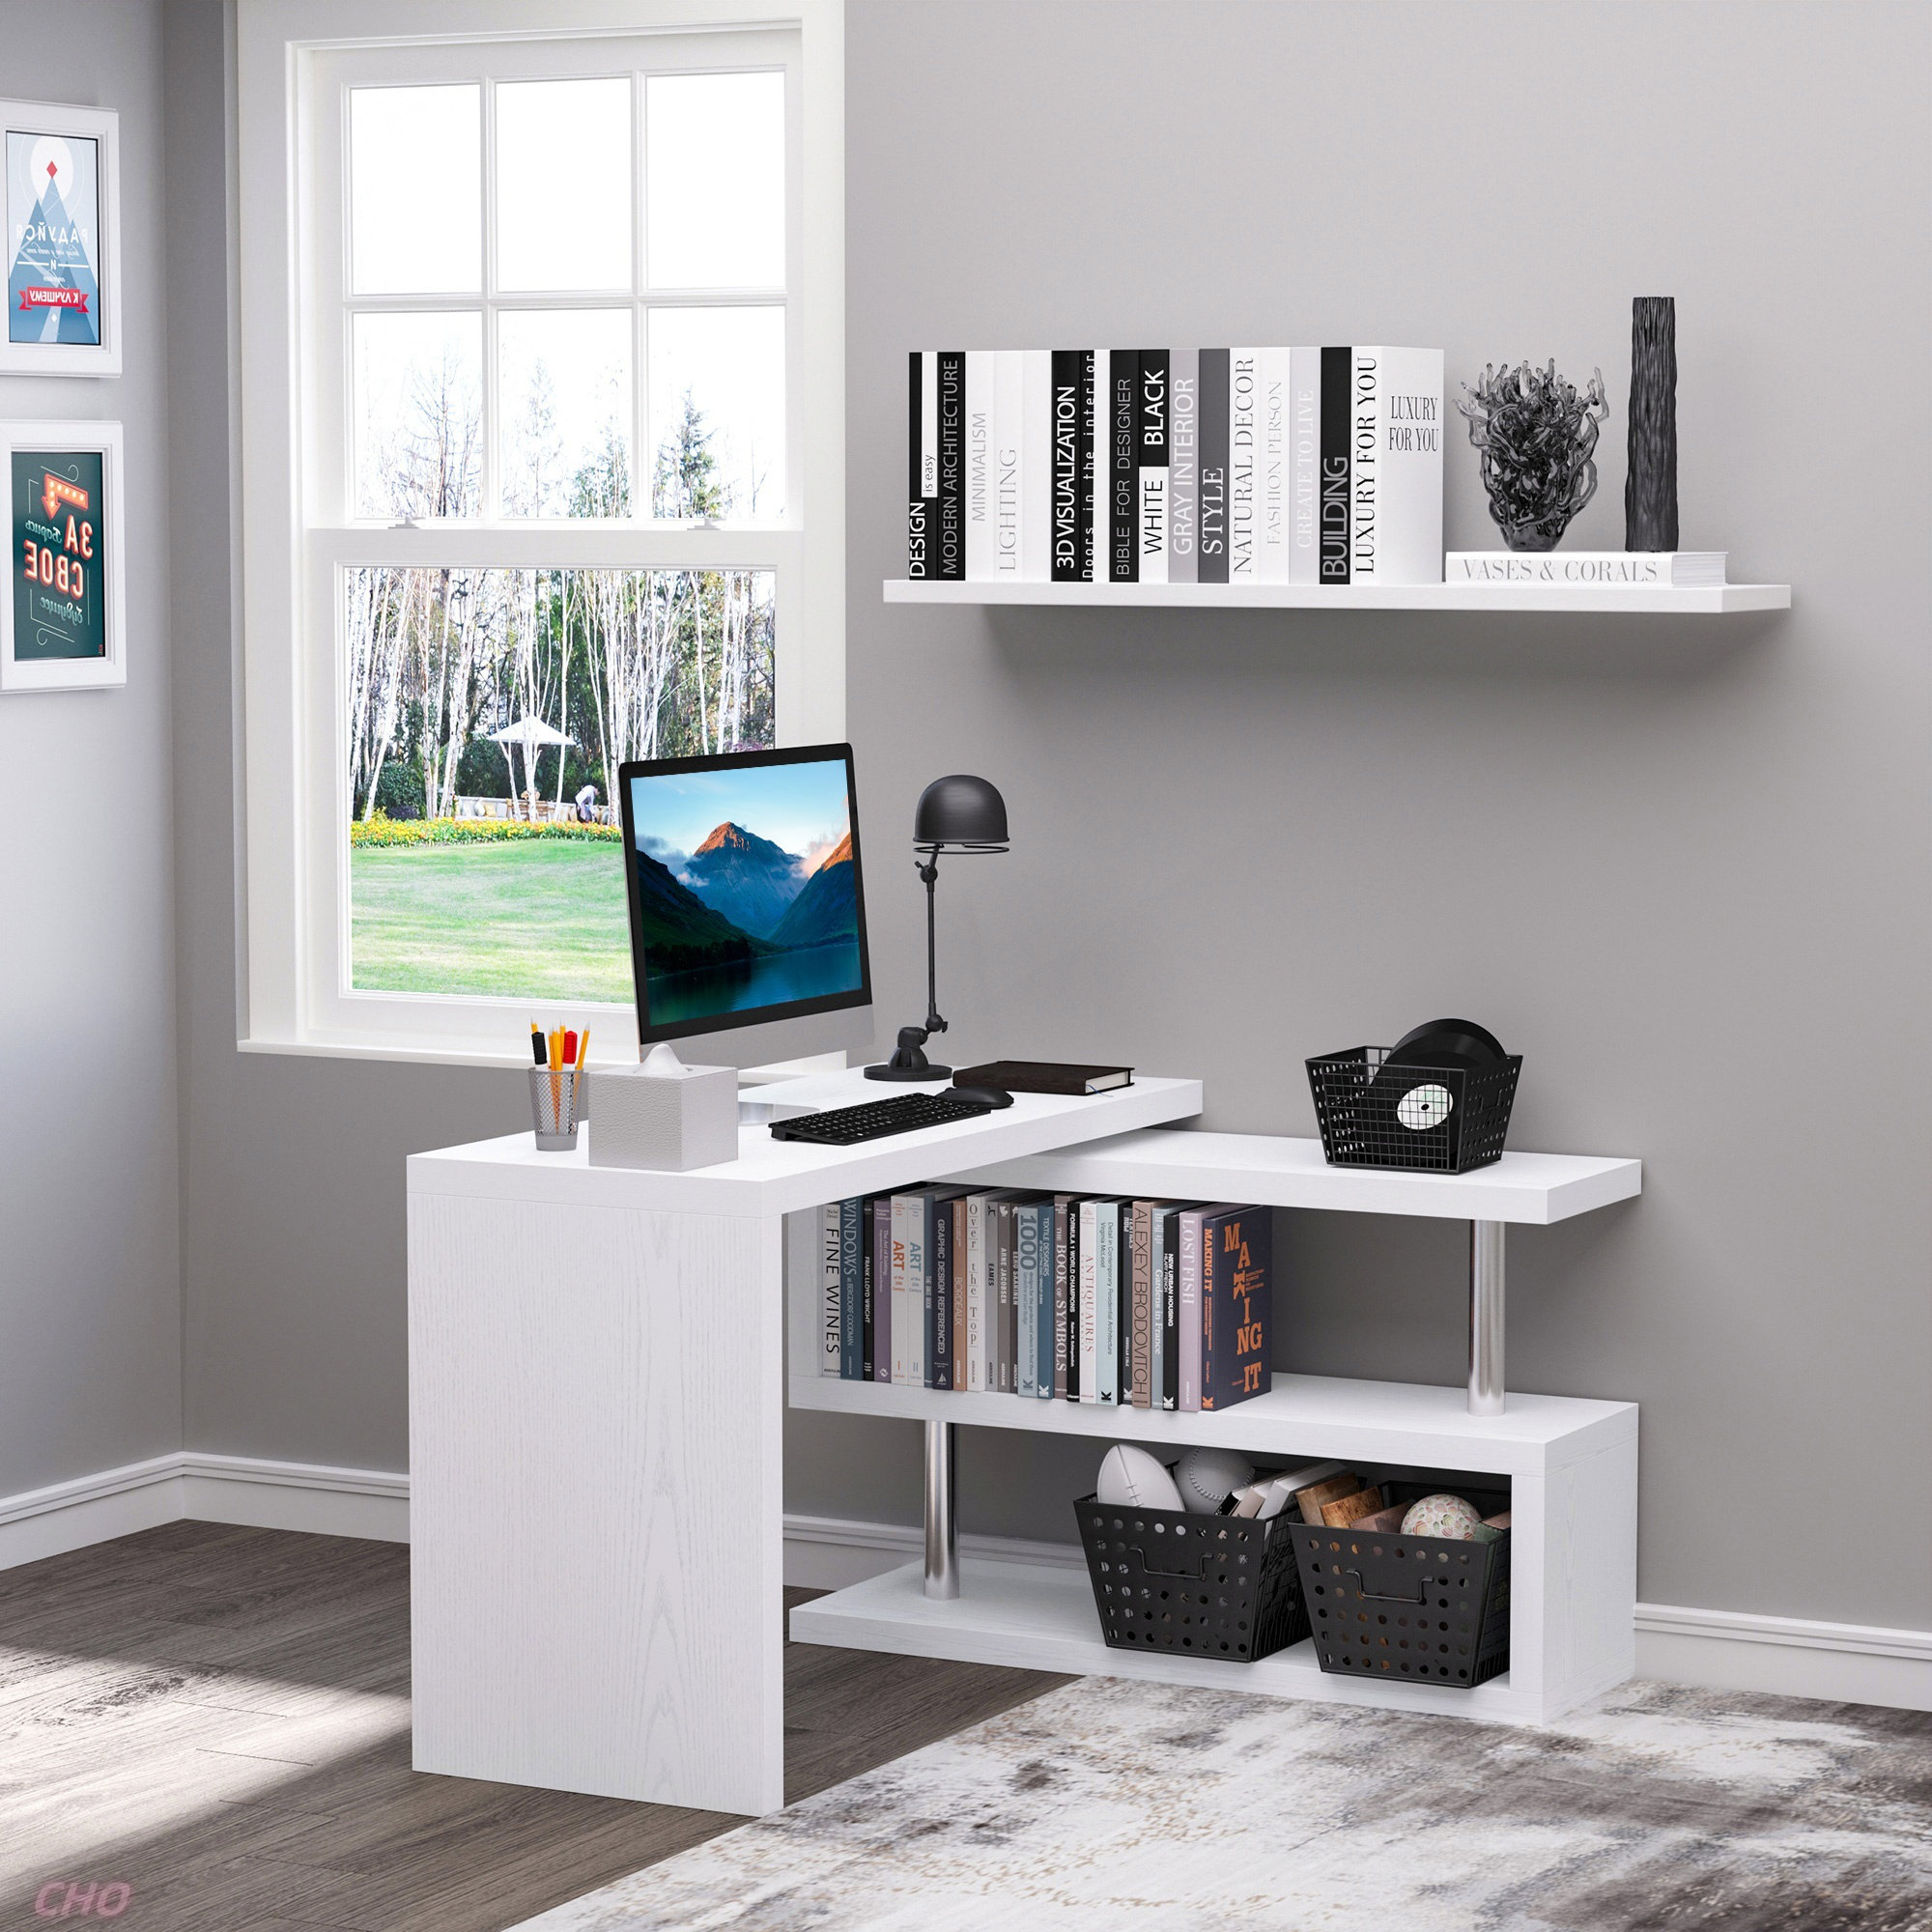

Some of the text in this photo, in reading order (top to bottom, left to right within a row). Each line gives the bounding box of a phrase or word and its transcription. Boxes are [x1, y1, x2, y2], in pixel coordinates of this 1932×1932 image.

[1144, 369, 1165, 445] BLACK
[1389, 427, 1439, 451] FOR YOU
[1391, 395, 1438, 420] LUXURY
[923, 454, 935, 493] is easy
[943, 359, 958, 574] MODERN ARCHITECTURE
[972, 412, 986, 522] MINIMALISM
[1056, 386, 1076, 569] 3D VISUALIZATION
[1082, 355, 1094, 579] Doors in the interior
[1117, 379, 1131, 576] BIBLE FOR DESIGNER
[1173, 378, 1194, 554] GRAY INTERIOR
[1234, 358, 1254, 574] NATURAL DECOR
[1266, 382, 1283, 545] FASHION PERSON
[1297, 389, 1314, 549] CREATE TO LIVE
[1355, 356, 1377, 574] LUXURY FOR YOU
[909, 502, 926, 577] DESIGN
[999, 448, 1017, 573] LIGHTING
[1144, 480, 1162, 554] WHITE
[1202, 468, 1224, 554] STYLE
[1322, 456, 1349, 576] BUILDING
[1463, 559, 1657, 582] VASES & CORALS
[826, 1228, 839, 1274] FINE
[843, 1199, 857, 1275] WINDOWS
[893, 1240, 905, 1270] ART
[910, 1241, 922, 1272] ART
[937, 1219, 946, 1259] GRAPHIC
[1020, 1214, 1037, 1270] 1000
[1056, 1244, 1067, 1285] BOOK
[1134, 1207, 1149, 1277] ALEXEY
[1181, 1219, 1195, 1305] LOST FISH
[1204, 1228, 1213, 1276] MAKING
[937, 1261, 946, 1293] DESIGN
[954, 1276, 963, 1326] BORDEAUX
[1056, 1288, 1062, 1297] OF
[1083, 1255, 1094, 1352] ANTIQUAIRES
[1154, 1268, 1163, 1354] Gardens in France
[1204, 1278, 1213, 1293] IT
[826, 1285, 840, 1353] WINES
[937, 1295, 946, 1354] REFERENCED
[1056, 1299, 1067, 1372] SYMBOLS
[1134, 1282, 1149, 1394] BRODOVITCH
[1243, 1361, 1262, 1393] IT
